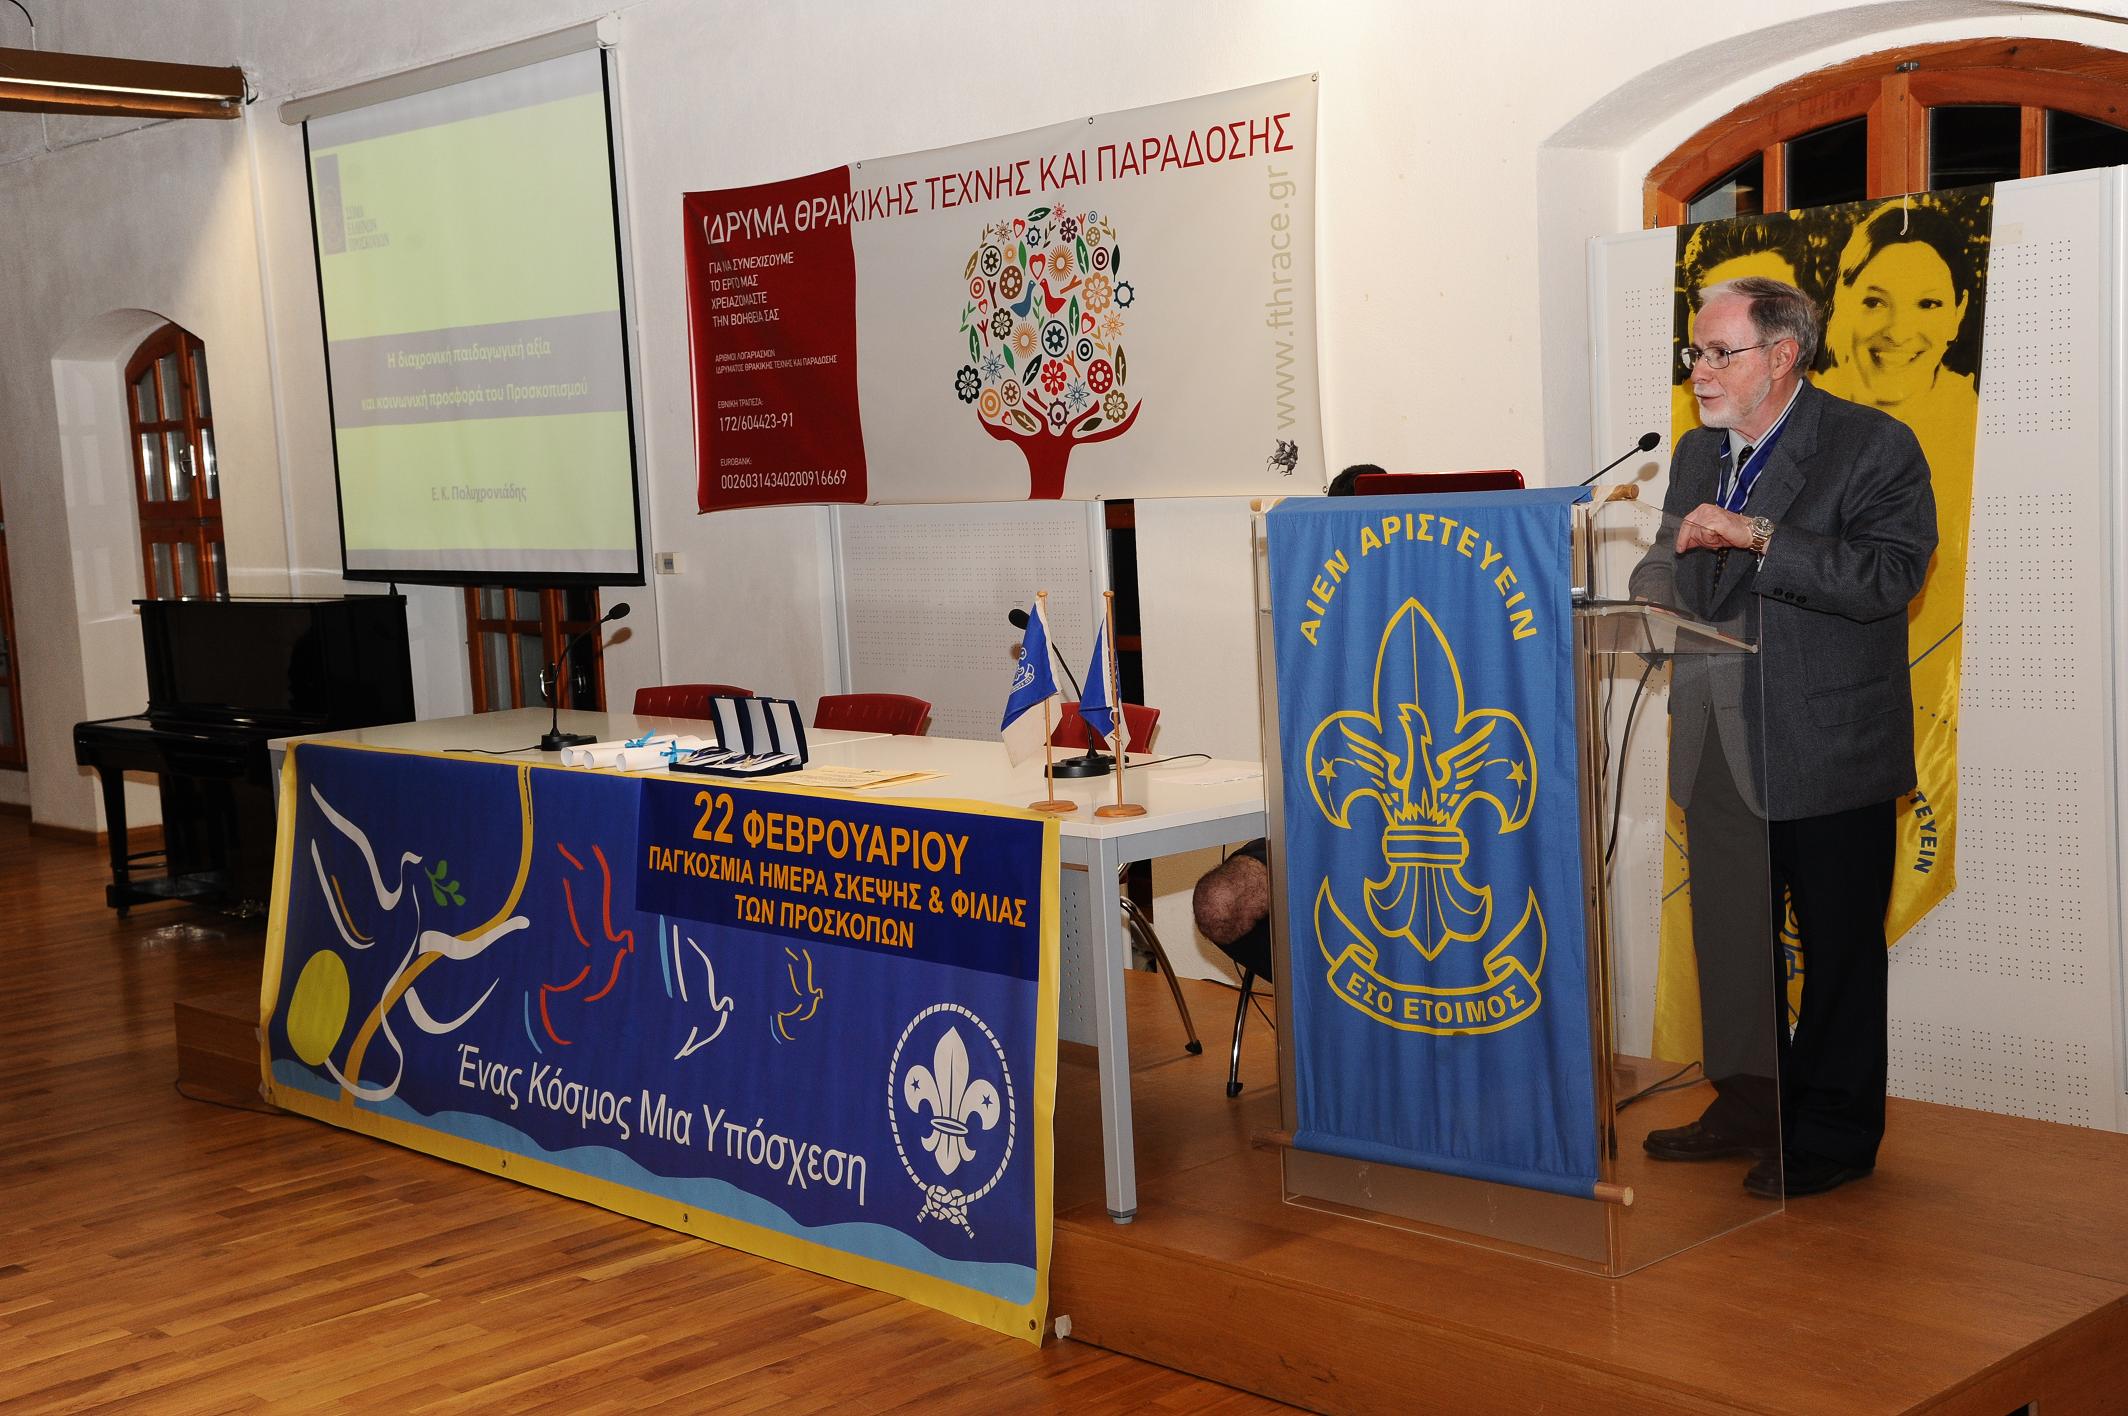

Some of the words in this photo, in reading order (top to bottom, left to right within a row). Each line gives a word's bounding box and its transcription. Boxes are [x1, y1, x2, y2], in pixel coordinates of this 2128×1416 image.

[703, 204, 789, 244] ΙΔΡΥΜΑ
[794, 181, 918, 231] ΘΡΑΚΙΚΗΣ
[925, 160, 1031, 209] ΤΕΧΝΗΣ
[1040, 150, 1086, 191] ΚΑΙ
[1098, 113, 1293, 181] ΠΑΡΑΔΟΣΗΣ
[709, 262, 723, 274] ΓΙΑ
[733, 252, 794, 270] ΣΥΝΕΧΙΣΟΥΜΕ
[710, 280, 720, 292] ΤΟ
[722, 277, 740, 291] ΕΡΓΟ
[741, 275, 758, 288] ΜΑΣ
[711, 292, 767, 310] ΧΡΕΙΑΖΟΜΑΣΤΕ
[712, 315, 729, 328] ΤΗΝ
[730, 311, 764, 326] ΒΟΗΘΕΙΑ
[764, 309, 780, 322] ΣΑΣ
[1265, 165, 1297, 430] www.fthrace.gr
[387, 353, 396, 369] Η
[399, 345, 451, 369] διαχρονική
[453, 341, 524, 364] παιδαγωγική
[526, 336, 551, 358] αξία
[802, 354, 838, 366] ΠΑΡΑΔΟΣΗΣ
[485, 386, 503, 401] του
[506, 377, 588, 402] Προσκοπισμού
[720, 412, 793, 432] 172/604423-91
[721, 469, 847, 489] 00260314340200916669
[1300, 549, 1349, 646] ΑΙΕΝ
[1360, 513, 1537, 641] ΑΡΙΣΤΕΥΕΙΝ
[692, 790, 735, 844] 22
[742, 809, 969, 875] ΦΕΒΡΟΥΑΡΙΟΥ
[1909, 790, 1938, 874] ΤΕΥΕΙΝ
[648, 845, 754, 886] ΠΑΓΚΟΣΜΙΑ
[759, 861, 829, 897] ΗΜΕΡΑ
[834, 875, 922, 911] ΣΚΕΨΗΣ
[928, 886, 944, 914] &
[950, 888, 1027, 928] ΦΙΛΙΑΣ
[735, 893, 775, 925] ΤΩΝ
[780, 902, 914, 949] ΠΡΟΣΚΟΠΩΝ
[1346, 972, 1393, 1013] ΕΣΟ
[1404, 985, 1525, 1024] ΕΤΟΙΜΟΣ
[458, 1044, 523, 1110] Ένας
[528, 1061, 632, 1140] Κόσμος
[639, 1089, 693, 1146] Μια
[703, 1103, 867, 1206] Υπόσχεση
